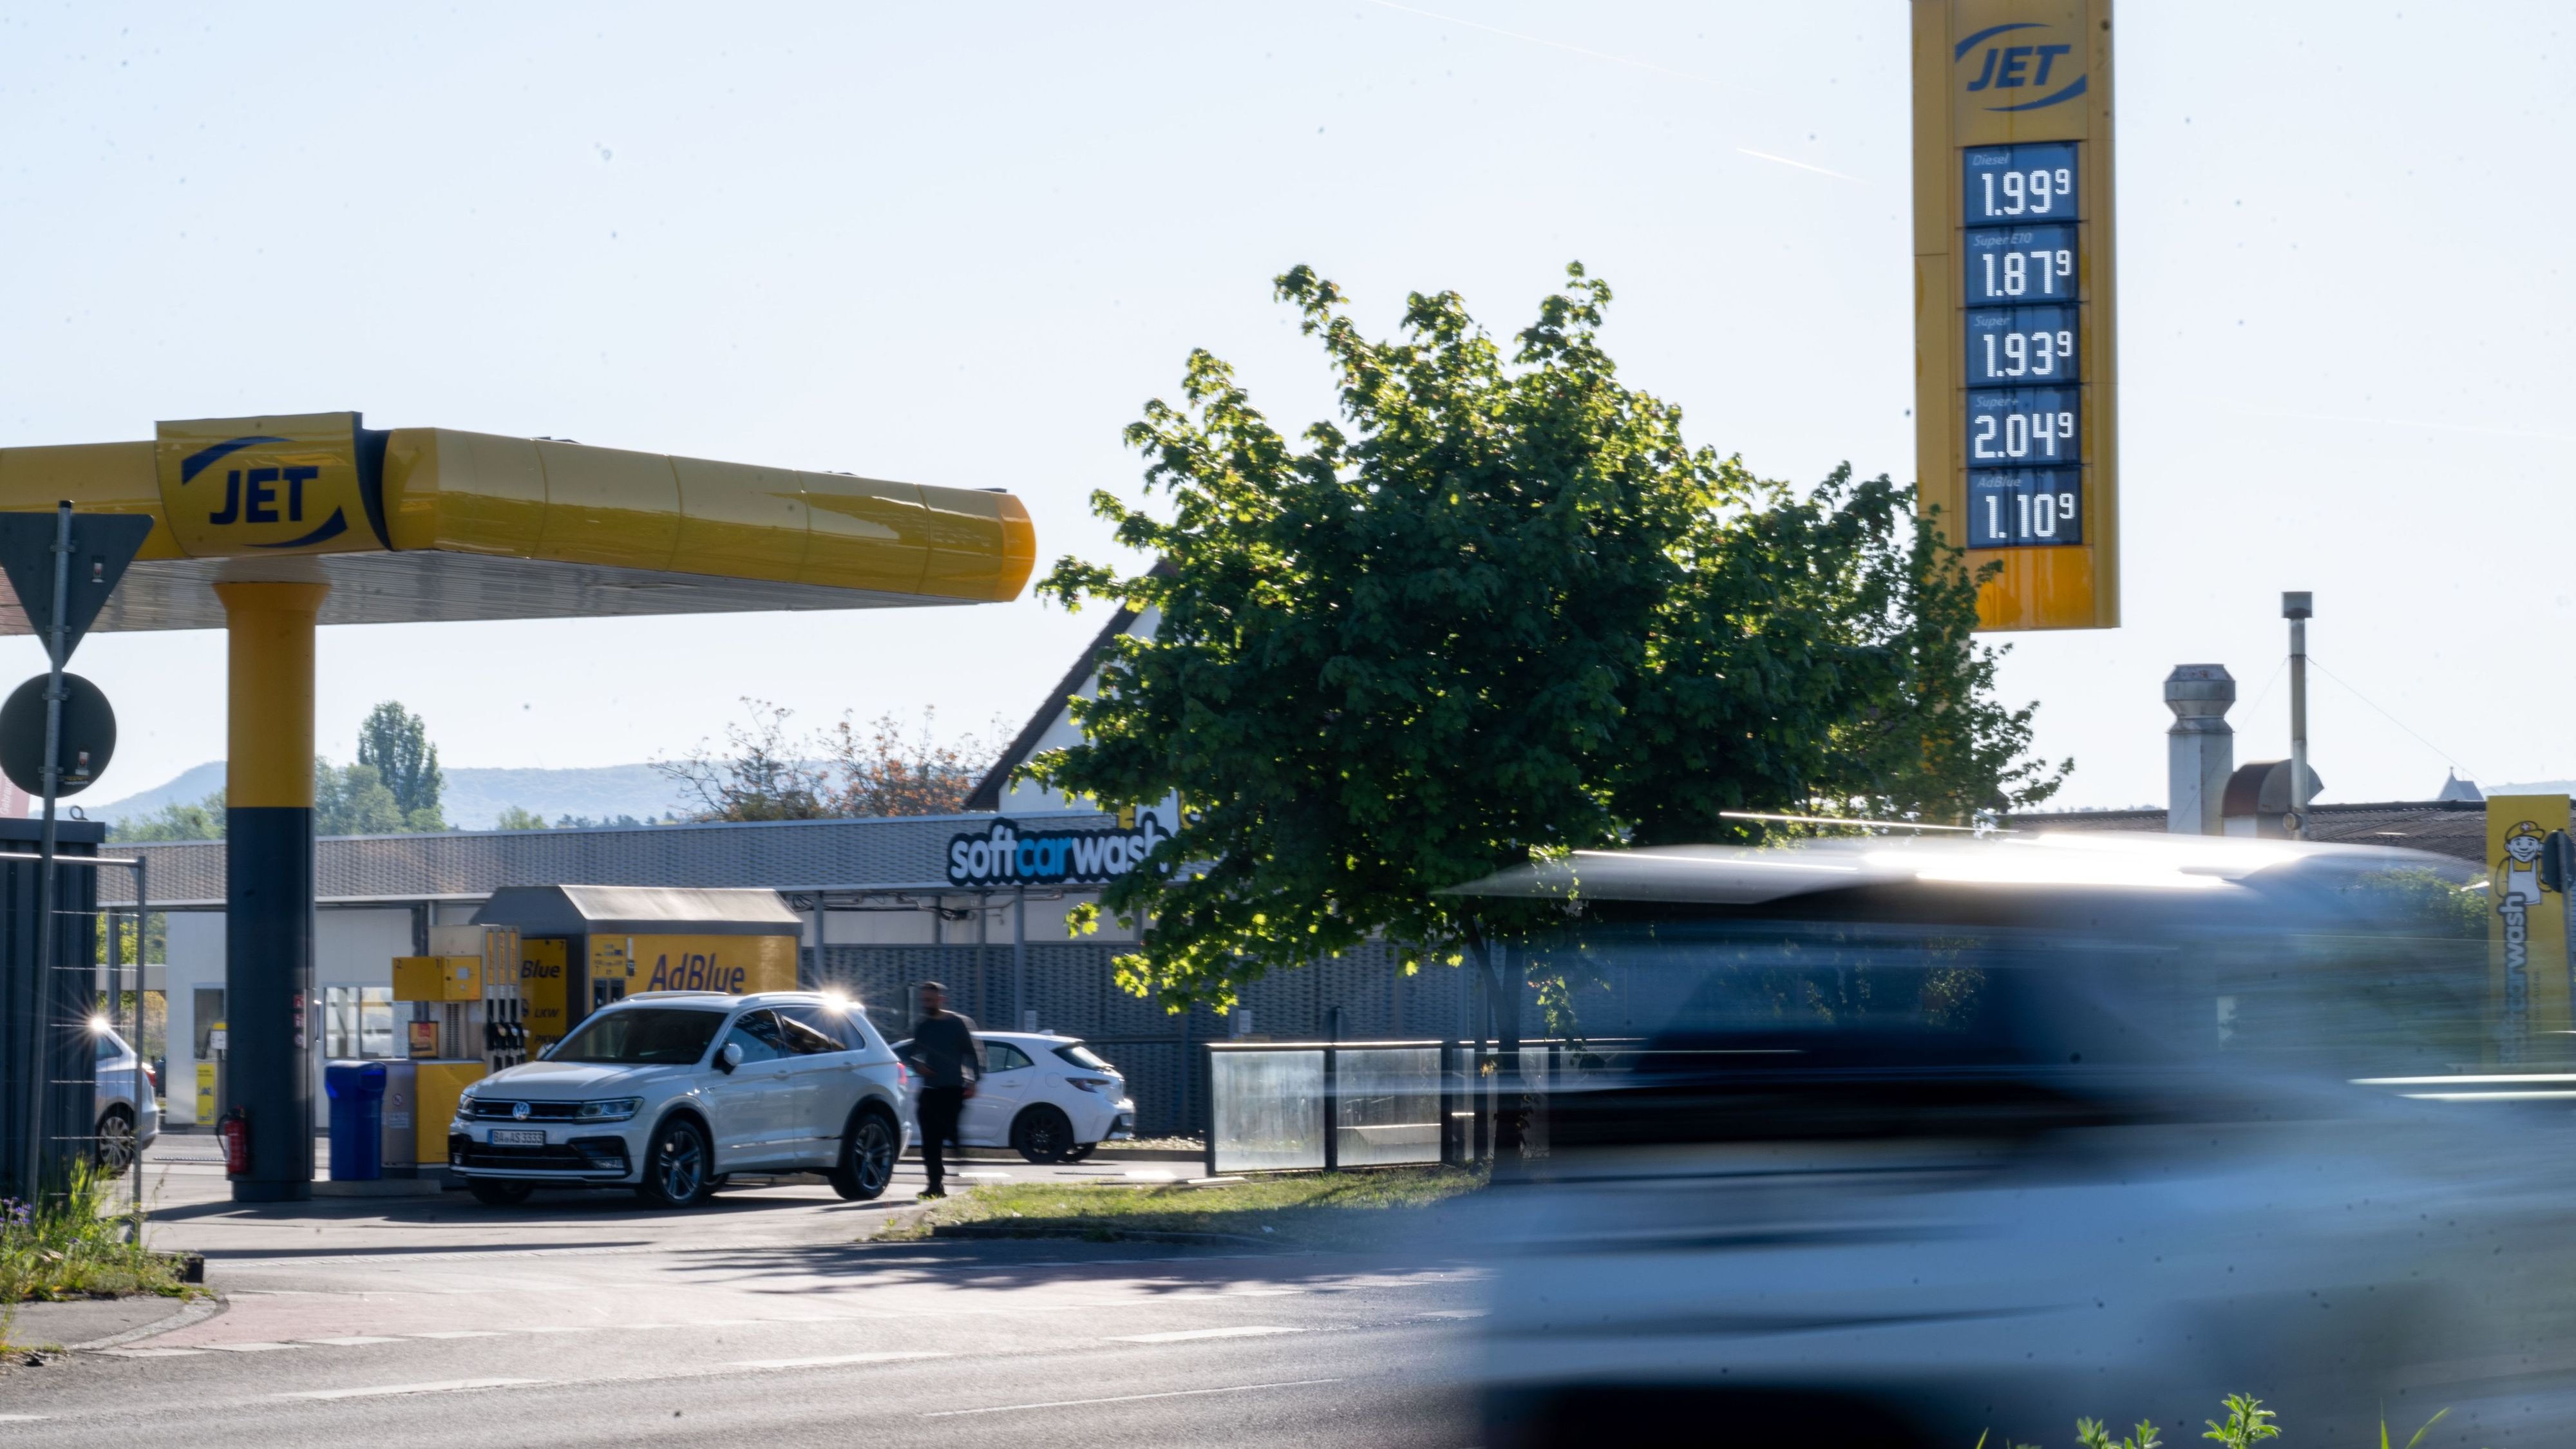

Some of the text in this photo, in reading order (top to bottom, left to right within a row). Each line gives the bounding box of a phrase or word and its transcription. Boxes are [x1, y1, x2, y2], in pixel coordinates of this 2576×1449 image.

[1966, 44, 2072, 91] JET
[1972, 152, 2011, 166] Diesel
[1973, 232, 2034, 249] Super E10
[1975, 315, 2011, 328] Super
[1976, 476, 2022, 488] AdBlue
[210, 466, 318, 525] JET
[1, 775, 14, 815] Gebrauc
[647, 952, 744, 994] AdBlue
[534, 1008, 560, 1018] LKW
